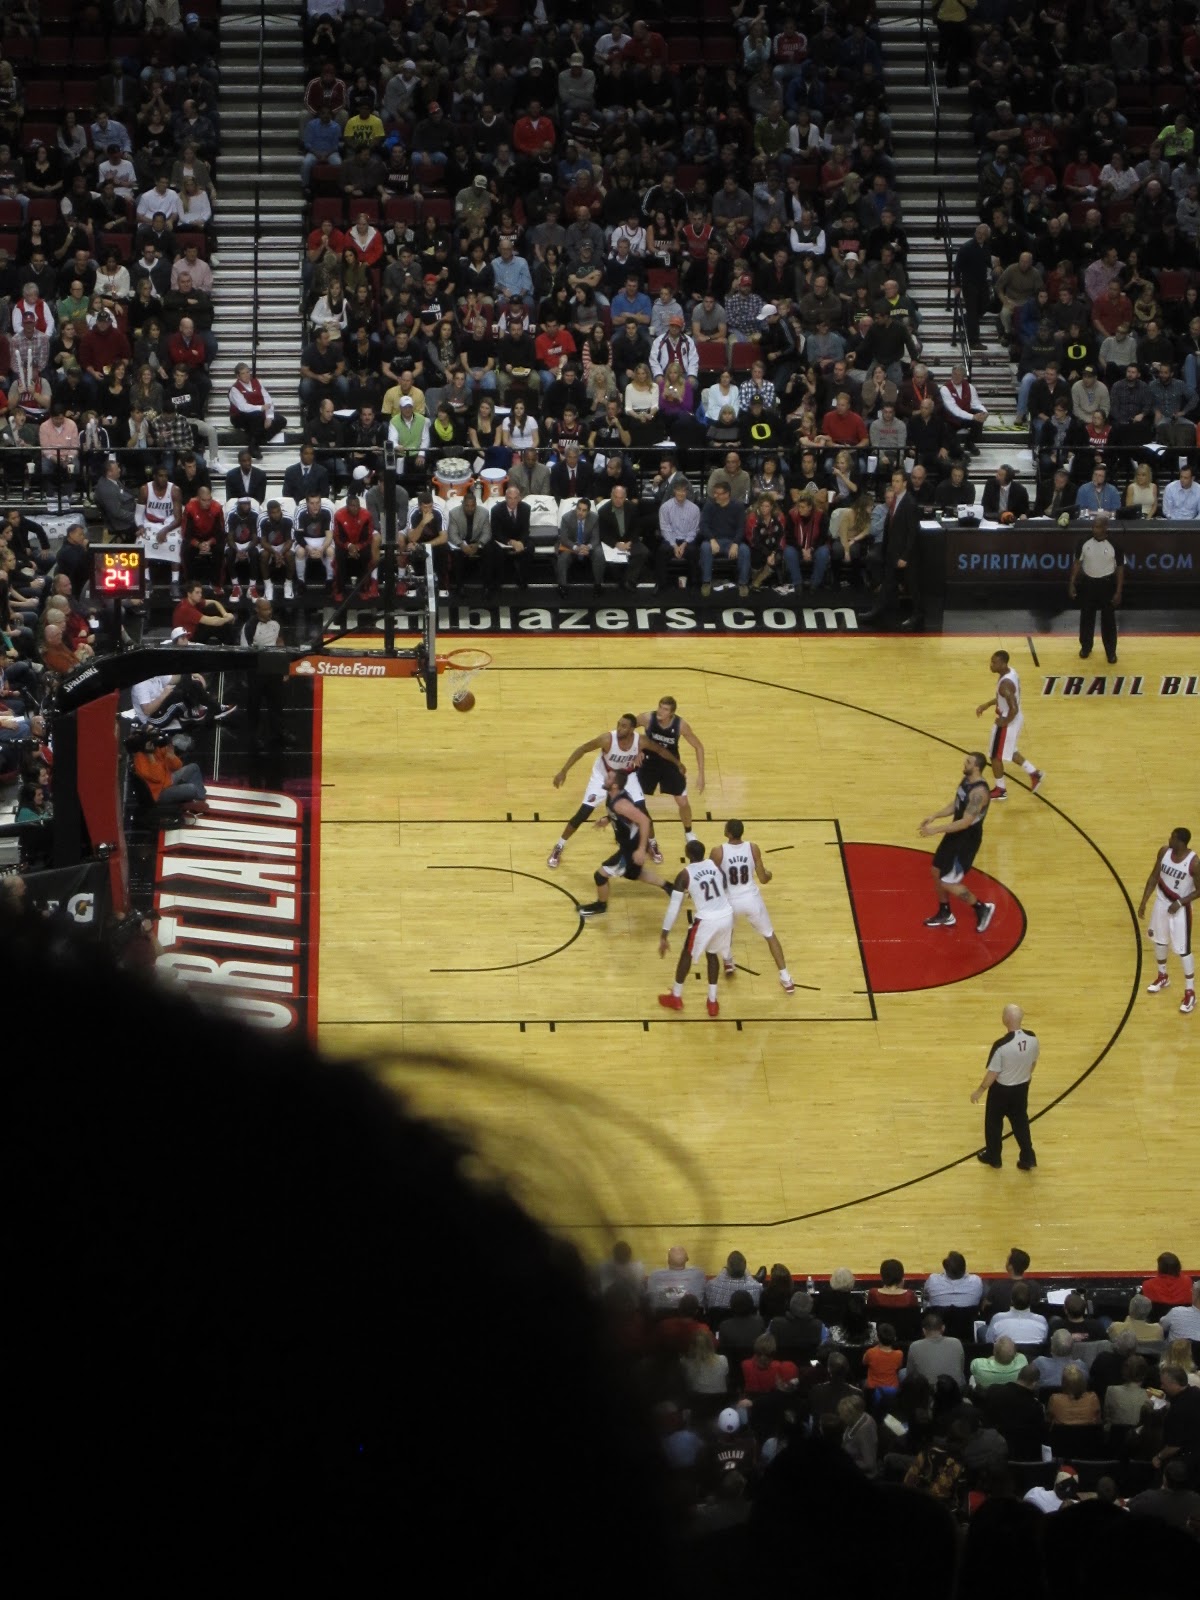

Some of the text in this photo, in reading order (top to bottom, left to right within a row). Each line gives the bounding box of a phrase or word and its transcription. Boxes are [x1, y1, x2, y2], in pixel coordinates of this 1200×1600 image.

[1067, 344, 1087, 359] O
[751, 423, 771, 440] O
[148, 501, 172, 509] BLAZERS
[105, 552, 139, 567] 6:50
[958, 553, 1194, 570] SPIRITMOUN.COM
[104, 568, 131, 588] 24
[64, 666, 99, 693] SPALDING
[1042, 675, 1146, 697] TRAIL
[728, 864, 750, 886] 88
[1161, 863, 1188, 881] BLAZERS
[699, 877, 721, 902] 21
[1173, 880, 1180, 890] 2
[155, 785, 299, 1030] ORTLAND
[1017, 1039, 1027, 1052] 17
